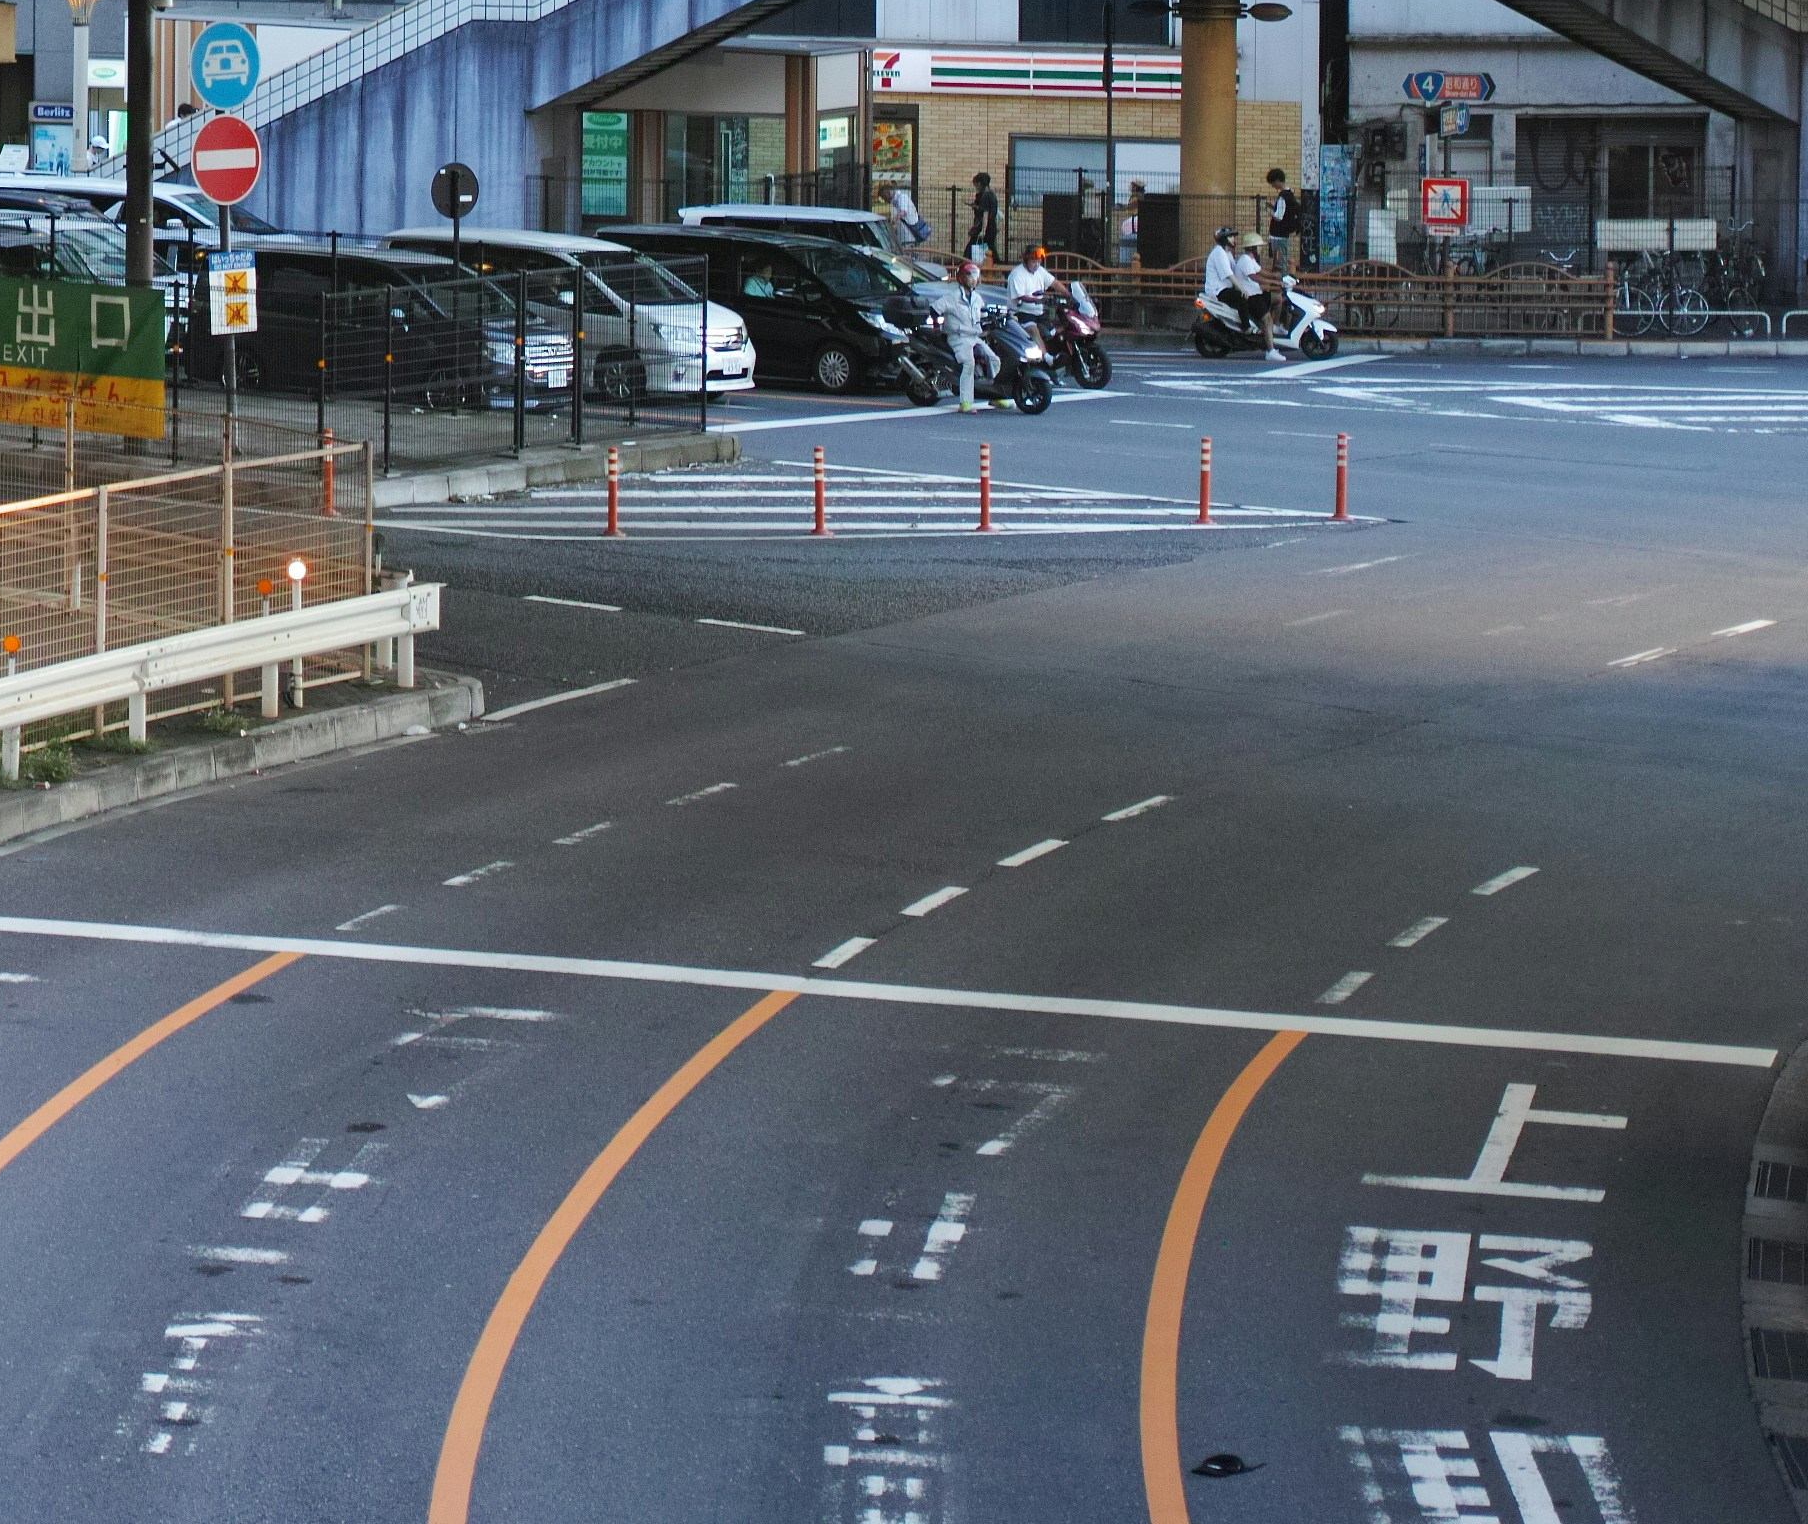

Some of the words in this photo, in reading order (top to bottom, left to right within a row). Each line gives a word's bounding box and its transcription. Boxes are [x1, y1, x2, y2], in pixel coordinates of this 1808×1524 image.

[1422, 75, 1435, 93] 4
[37, 106, 71, 117] Berlitz
[3, 344, 49, 365] EXIT
